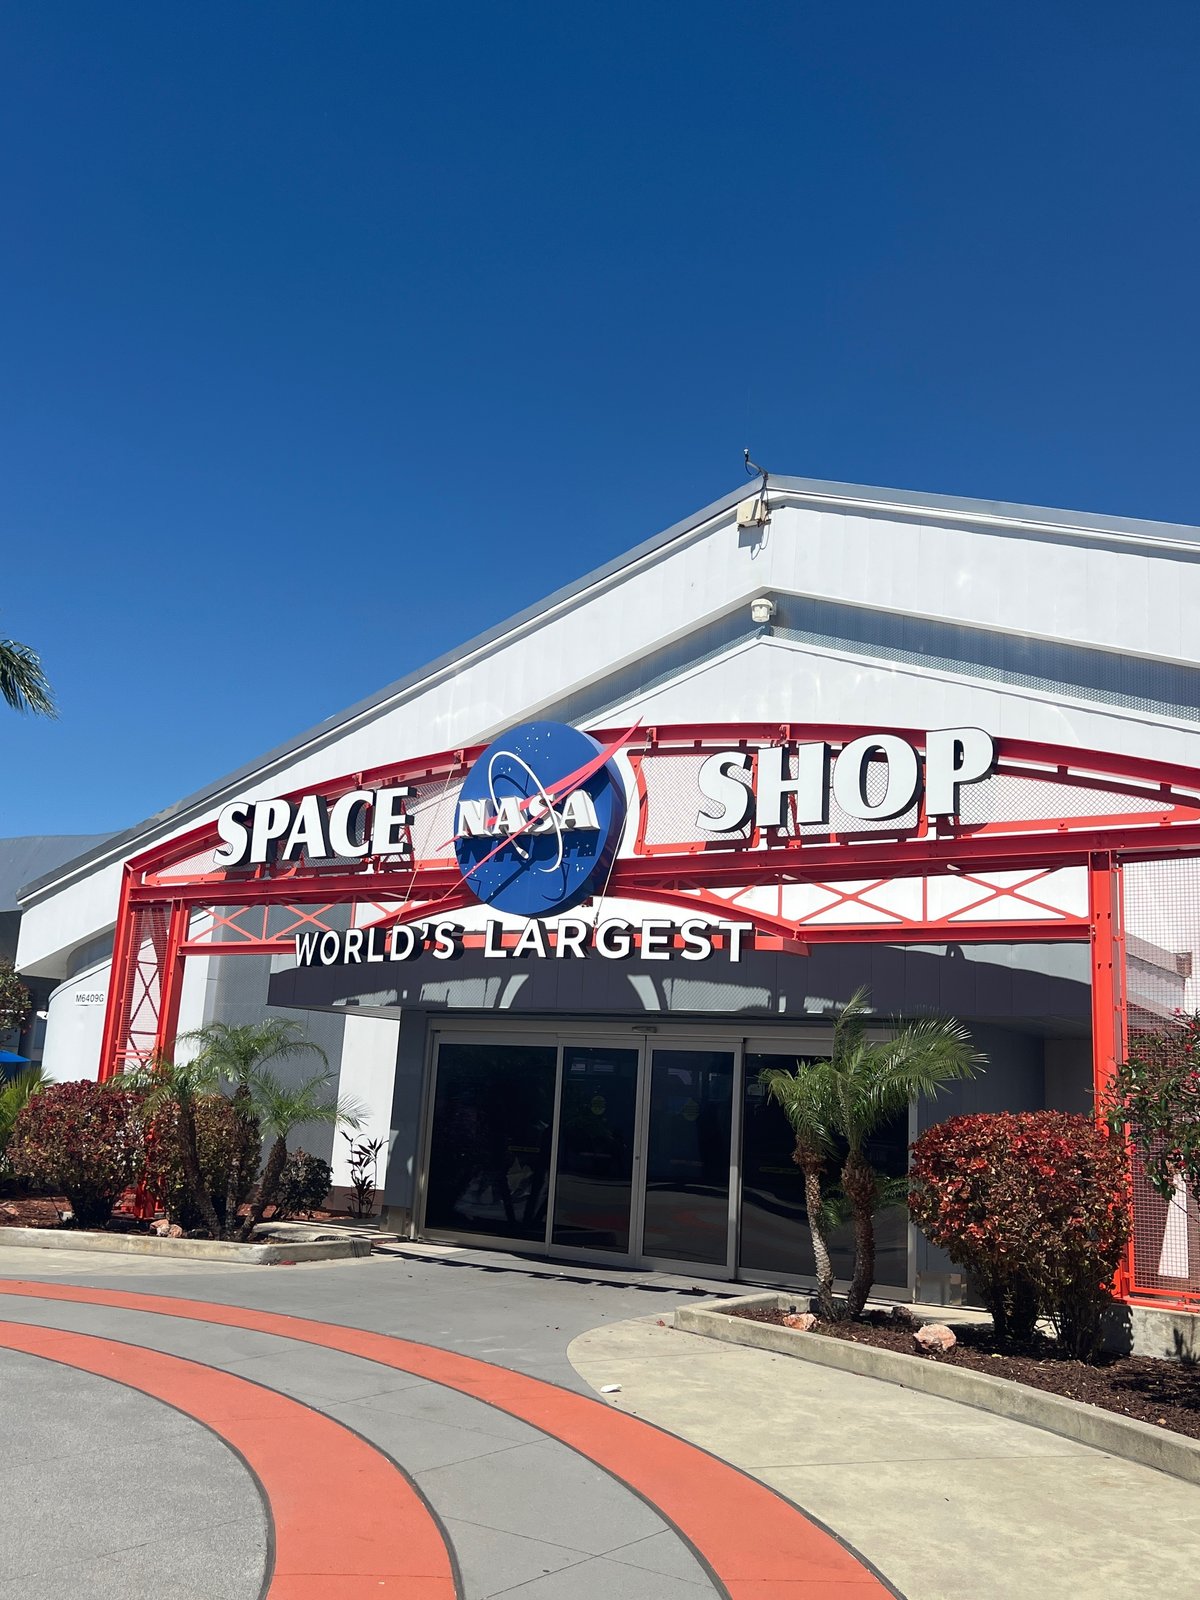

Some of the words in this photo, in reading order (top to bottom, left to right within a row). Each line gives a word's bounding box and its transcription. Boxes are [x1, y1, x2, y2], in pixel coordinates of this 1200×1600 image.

[213, 786, 412, 866] SPACE
[695, 726, 995, 833] SHOP
[456, 789, 601, 839] NASA
[295, 920, 461, 967] WORLD'S
[483, 917, 753, 963] LARGEST
[75, 993, 104, 1003] M6409G
